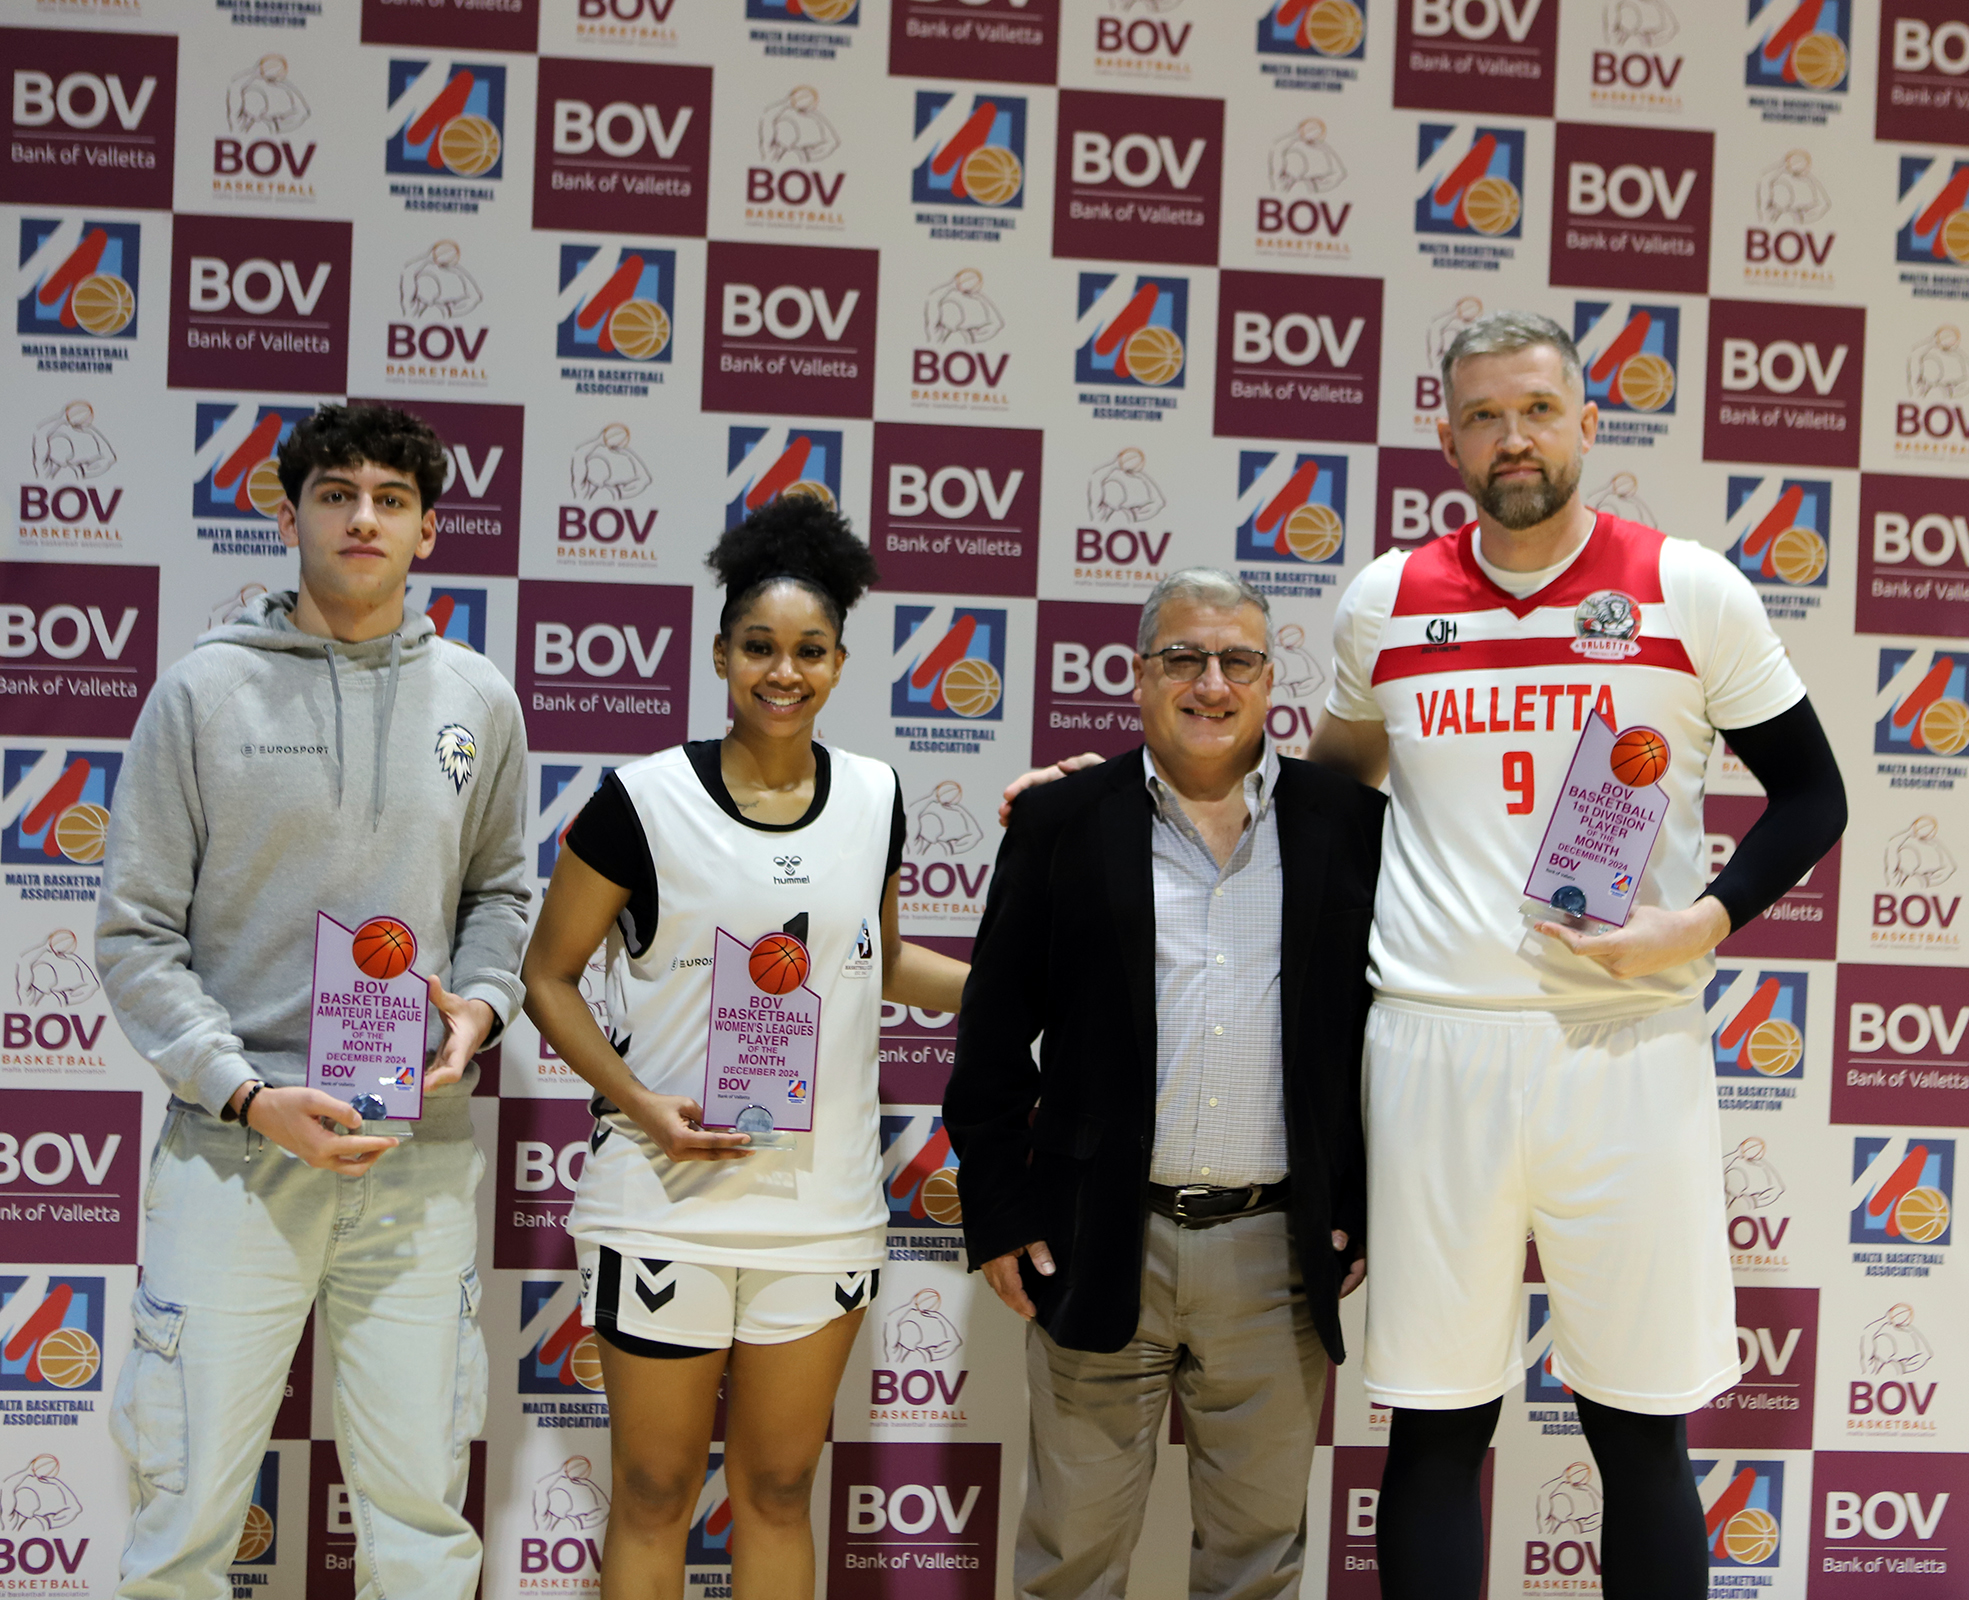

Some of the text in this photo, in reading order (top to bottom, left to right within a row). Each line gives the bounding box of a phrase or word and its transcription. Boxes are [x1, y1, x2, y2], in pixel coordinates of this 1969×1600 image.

[11, 69, 156, 130] BOV
[552, 100, 692, 160] BOV
[9, 141, 155, 167] Bank of Valletta
[213, 137, 316, 180] BOV
[1072, 130, 1205, 190] BOV
[551, 170, 690, 196] Bank of Valletta
[746, 166, 845, 208] BOV
[1568, 162, 1695, 221] BOV
[1256, 196, 1351, 237] BOV
[188, 256, 331, 316] BOV
[722, 282, 859, 341] BOV
[186, 327, 330, 352] Bank of Valletta
[386, 322, 488, 363] BOV
[1233, 309, 1365, 367] BOV
[720, 353, 857, 377] Bank of Valletta
[912, 347, 1009, 388] BOV
[1722, 338, 1847, 395] BOV
[1231, 378, 1363, 402] Bank of Valletta
[1720, 405, 1845, 429] Bank of Valletta
[18, 482, 122, 523] BOV
[887, 463, 1023, 520] BOV
[17, 524, 122, 539] BASKETBALL
[557, 504, 657, 544] BOV
[556, 546, 657, 560] BASKETBALL
[886, 532, 1021, 556] Bank of Valletta
[1075, 526, 1171, 566] BOV
[0, 602, 139, 661] BOV
[533, 621, 672, 678] BOV
[41, 675, 61, 695] of
[66, 676, 137, 697] Valletta
[531, 692, 670, 714] Bank of Valletta
[1416, 684, 1618, 738] VALLETTA
[894, 726, 993, 741] MALTA BASKETBALL
[259, 746, 328, 754] EUROSPORT
[908, 741, 978, 753] ASSOCIATION
[1502, 751, 1535, 815] 9
[1601, 782, 1633, 800] BOV
[1569, 786, 1655, 822] BASKETBALL
[1573, 801, 1645, 831] 1st DIVISION
[1580, 815, 1628, 839] PLAYER
[1575, 835, 1619, 857] MONTH
[1587, 829, 1614, 843] OF THE
[1549, 853, 1581, 871] BOV
[1558, 843, 1628, 871] DECEMBER 2024
[774, 876, 810, 885] hummel
[1872, 892, 1962, 930] BOV
[1871, 931, 1960, 944] BASKETBALL
[680, 957, 714, 968] EUROS
[354, 981, 388, 994] BOV
[320, 992, 420, 1009] BASKETBALL
[750, 996, 783, 1009] BOV
[317, 1006, 422, 1022] AMATEUR LEAGUE
[718, 1008, 812, 1023] BASKETBALL
[2, 1012, 105, 1051] BOV
[342, 1019, 395, 1032] PLAYER
[367, 1032, 384, 1040] THE
[715, 1021, 813, 1036] WOMEN'S LEAGUES
[1849, 1002, 1969, 1055] BOV
[343, 1040, 392, 1052] MONTH
[738, 1034, 788, 1046] PLAYER
[762, 1046, 777, 1054] THE
[1, 1054, 105, 1066] BASKETBALL
[327, 1053, 406, 1064] DECEMBER 2024
[739, 1054, 785, 1066] MONTH
[322, 1064, 355, 1077] BOV
[723, 1066, 799, 1077] DECEMBER 2024
[1847, 1069, 1969, 1089] Bank of Valletta
[719, 1078, 750, 1090] BOV
[24, 1201, 120, 1221] of Valletta
[1853, 1253, 1944, 1265] MALTA BASKETBALL
[1866, 1266, 1930, 1277] ASSOCIATION
[871, 1369, 967, 1406] BOV
[1849, 1380, 1938, 1415] BOV
[0, 1400, 93, 1412] ALTA BASKETBALL
[1716, 1393, 1800, 1411] of Valletta
[4, 1414, 78, 1425] ASSOCIATION
[870, 1410, 967, 1421] BASKETBALL
[1848, 1419, 1937, 1429] BASKETBALL
[848, 1484, 982, 1535] BOV
[1826, 1490, 1949, 1540] BOV
[846, 1552, 980, 1569] Bank of Valletta
[1824, 1555, 1947, 1573] Bank of Valletta
[0, 1578, 91, 1589] ASKETBALL
